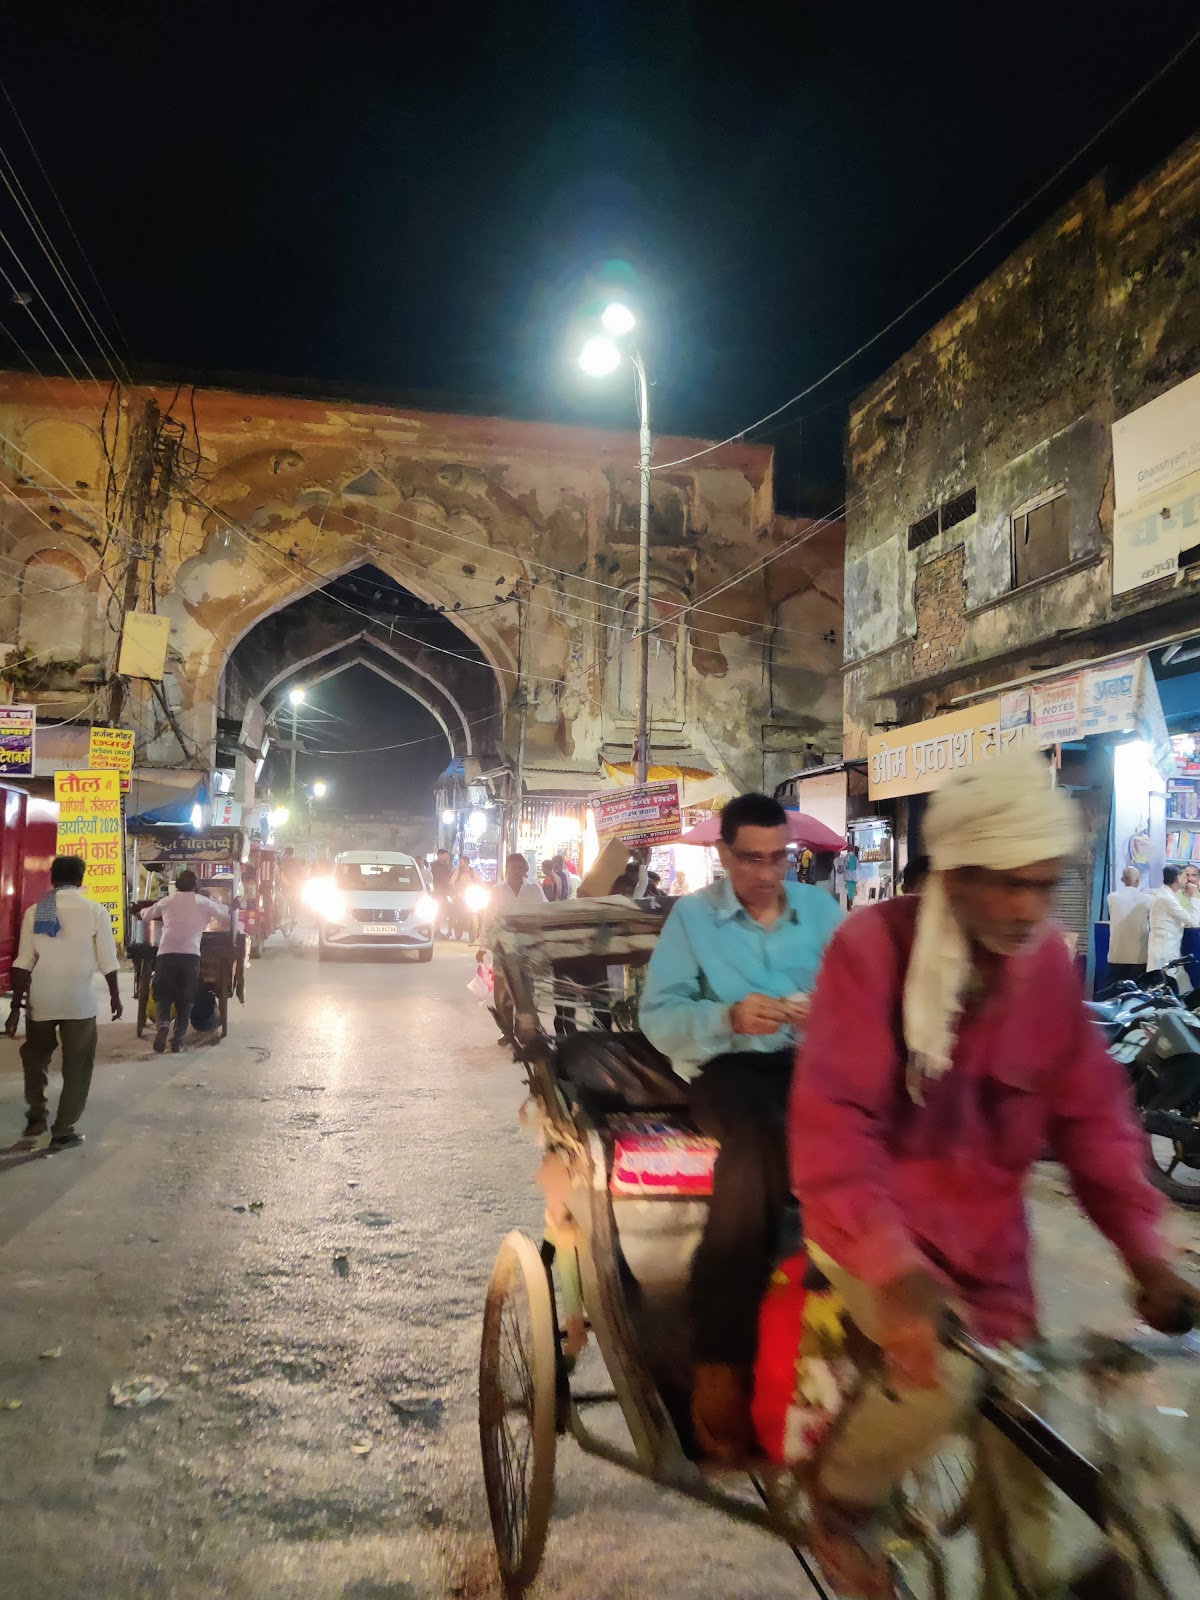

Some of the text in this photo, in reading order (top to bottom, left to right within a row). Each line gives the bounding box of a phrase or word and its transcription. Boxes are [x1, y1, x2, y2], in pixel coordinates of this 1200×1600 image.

[1138, 450, 1188, 482] Ghanshyam
[1043, 702, 1075, 715] NOTES
[92, 740, 131, 750] छपाई
[871, 741, 908, 785] ओम
[911, 727, 975, 781] प्रकाश
[58, 773, 102, 793] तौल
[99, 817, 119, 834] 2023
[91, 835, 119, 860] कार्ड
